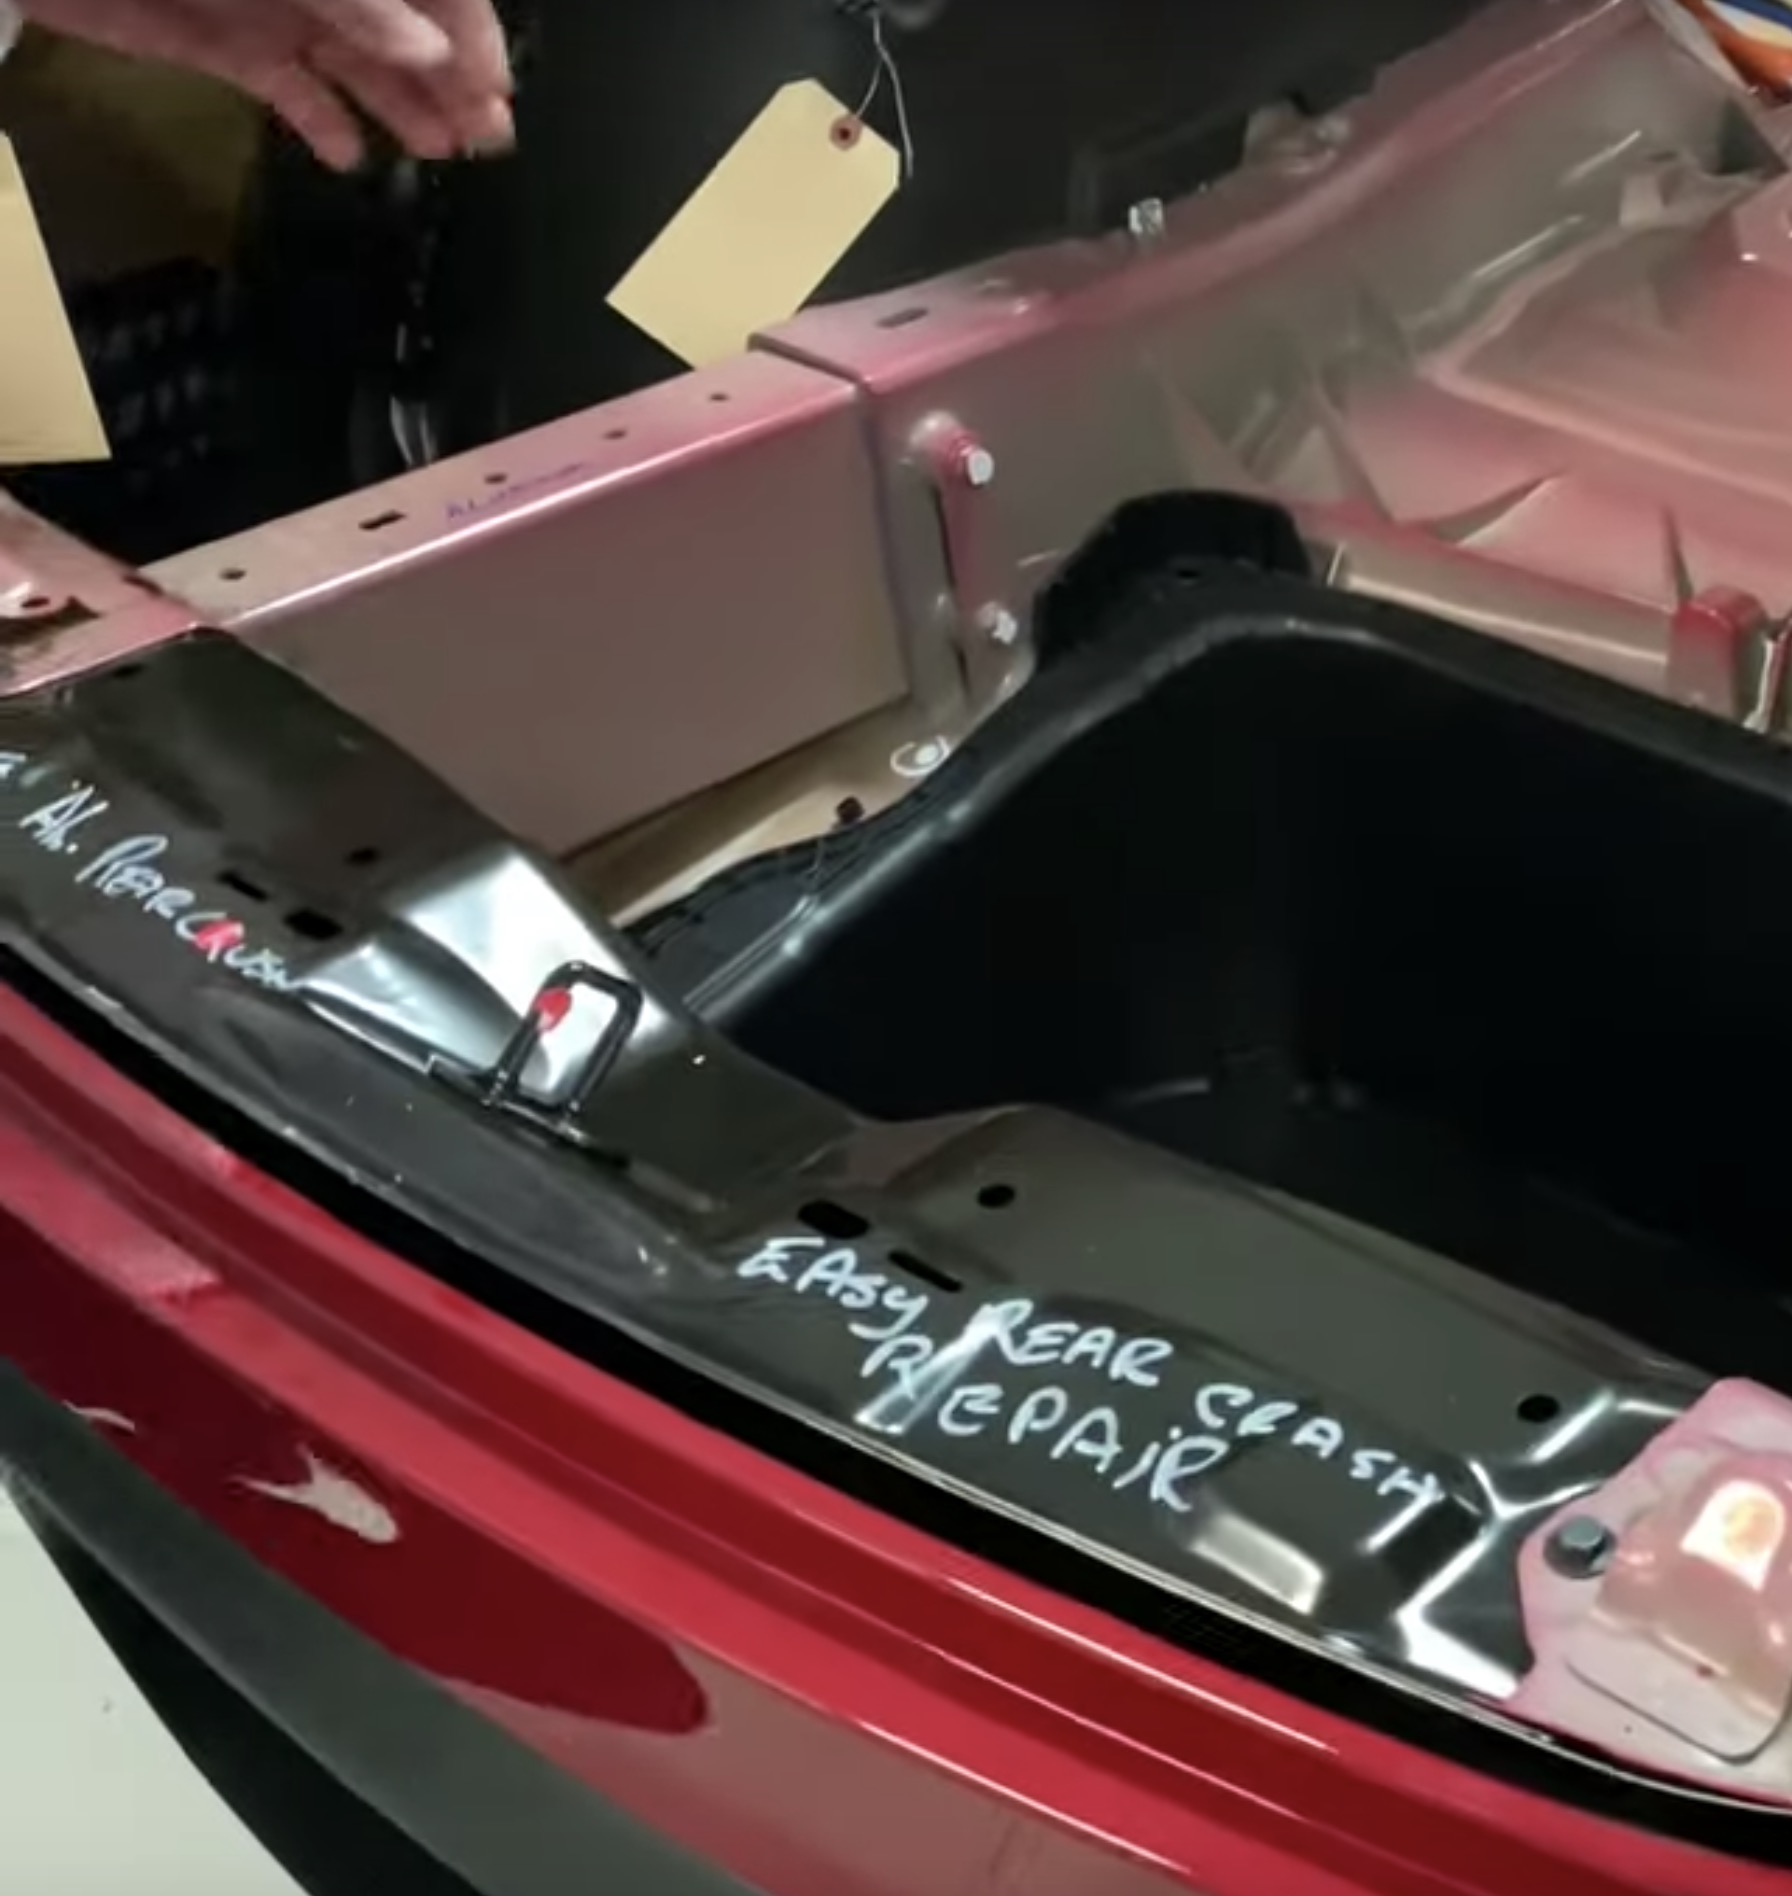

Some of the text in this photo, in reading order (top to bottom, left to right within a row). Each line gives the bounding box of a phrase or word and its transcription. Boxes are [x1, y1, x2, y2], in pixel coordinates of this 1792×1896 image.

[737, 1236, 1447, 1503] EASY REAR CRASH
